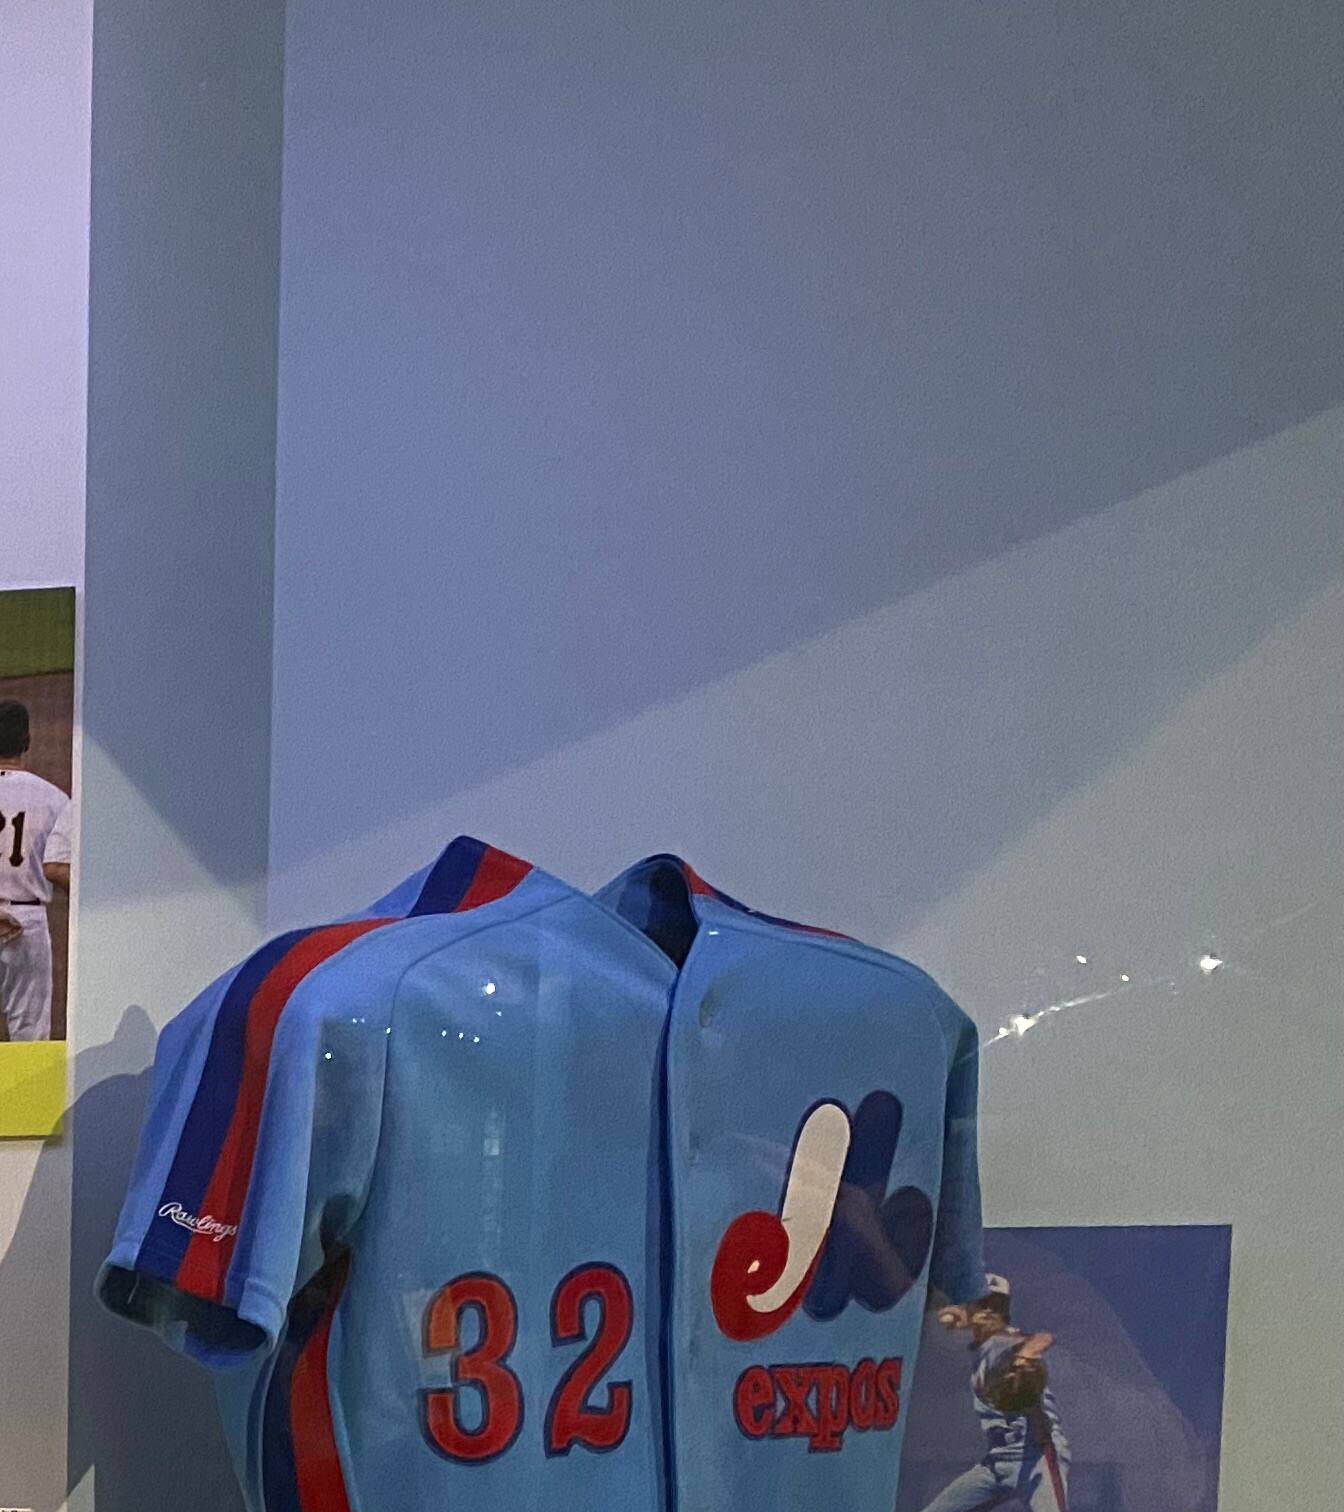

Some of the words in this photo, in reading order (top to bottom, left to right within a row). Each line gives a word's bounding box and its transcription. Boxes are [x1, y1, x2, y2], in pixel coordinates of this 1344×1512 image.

[158, 1202, 238, 1242] Rawlings
[418, 1261, 634, 1466] 32
[733, 1356, 903, 1453] expos
